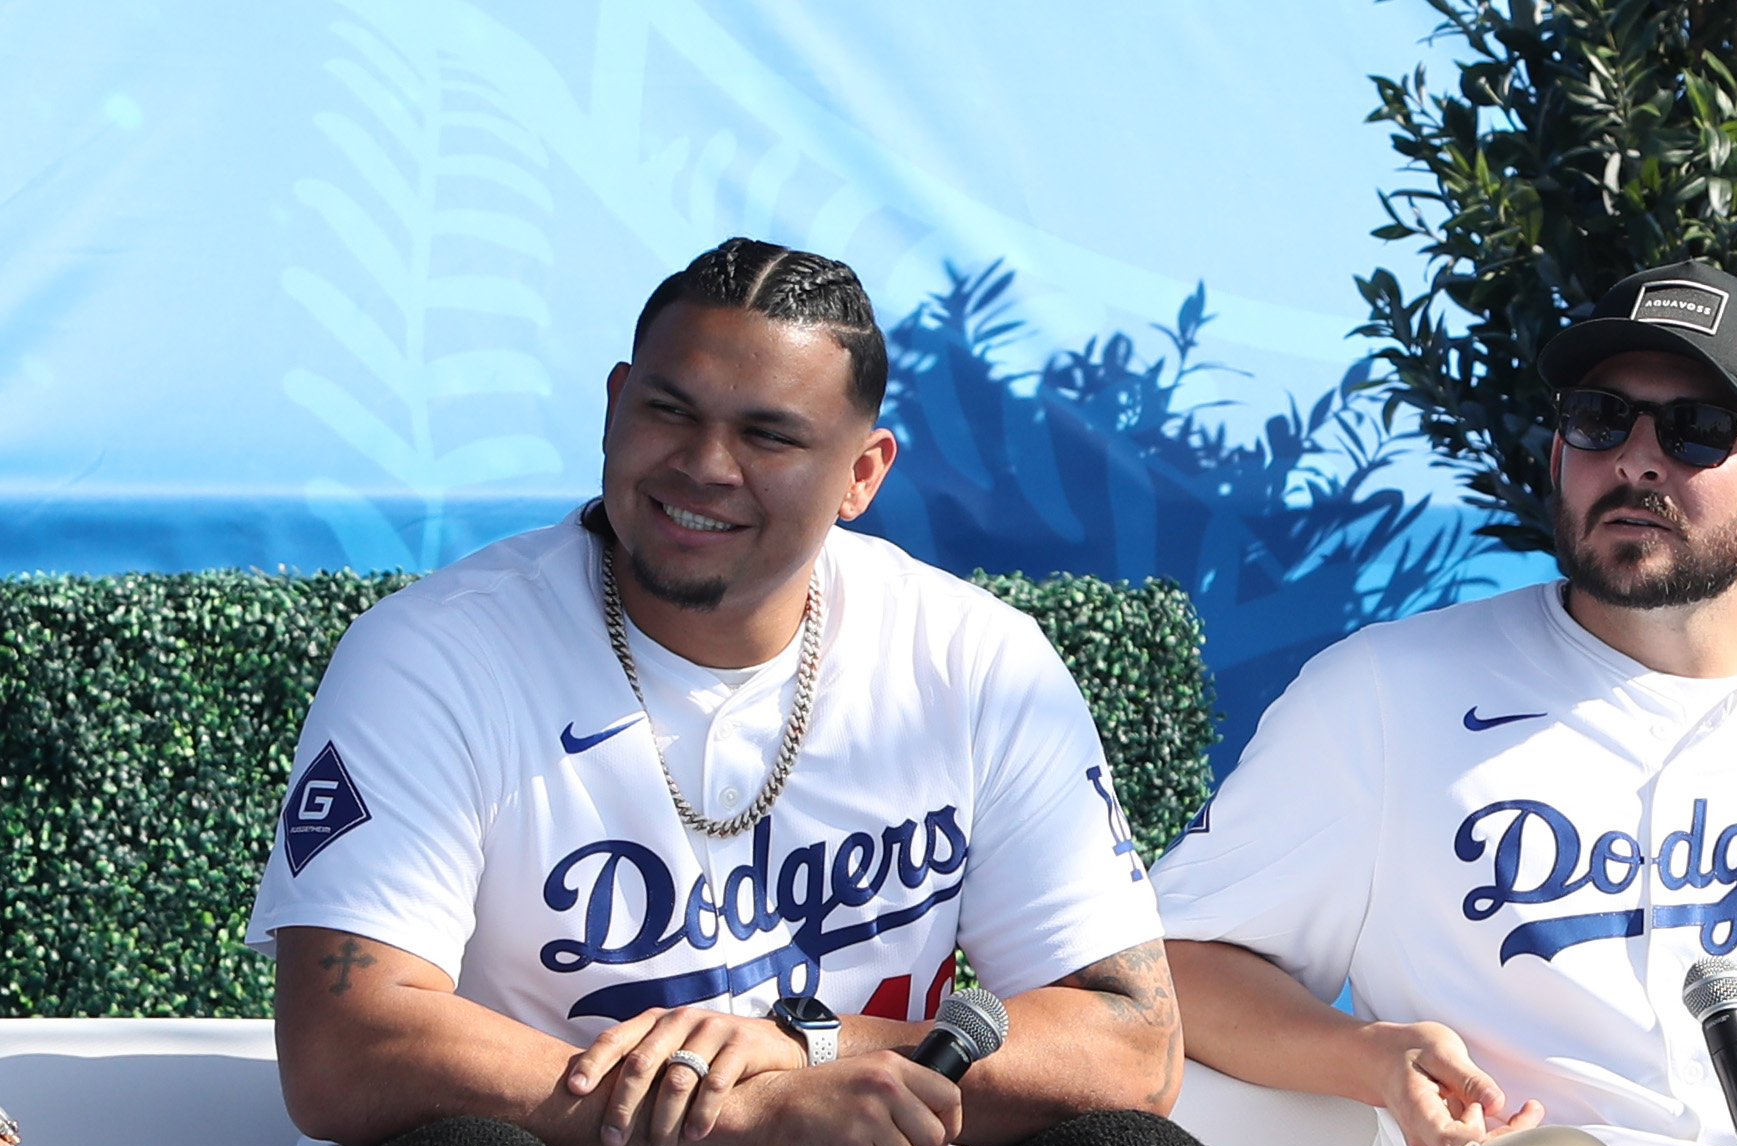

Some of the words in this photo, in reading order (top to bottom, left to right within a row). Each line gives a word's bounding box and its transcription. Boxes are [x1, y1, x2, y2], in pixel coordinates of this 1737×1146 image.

[1645, 299, 1712, 316] AQUAVOSS
[298, 780, 339, 820] G
[540, 804, 970, 999] Dodgers
